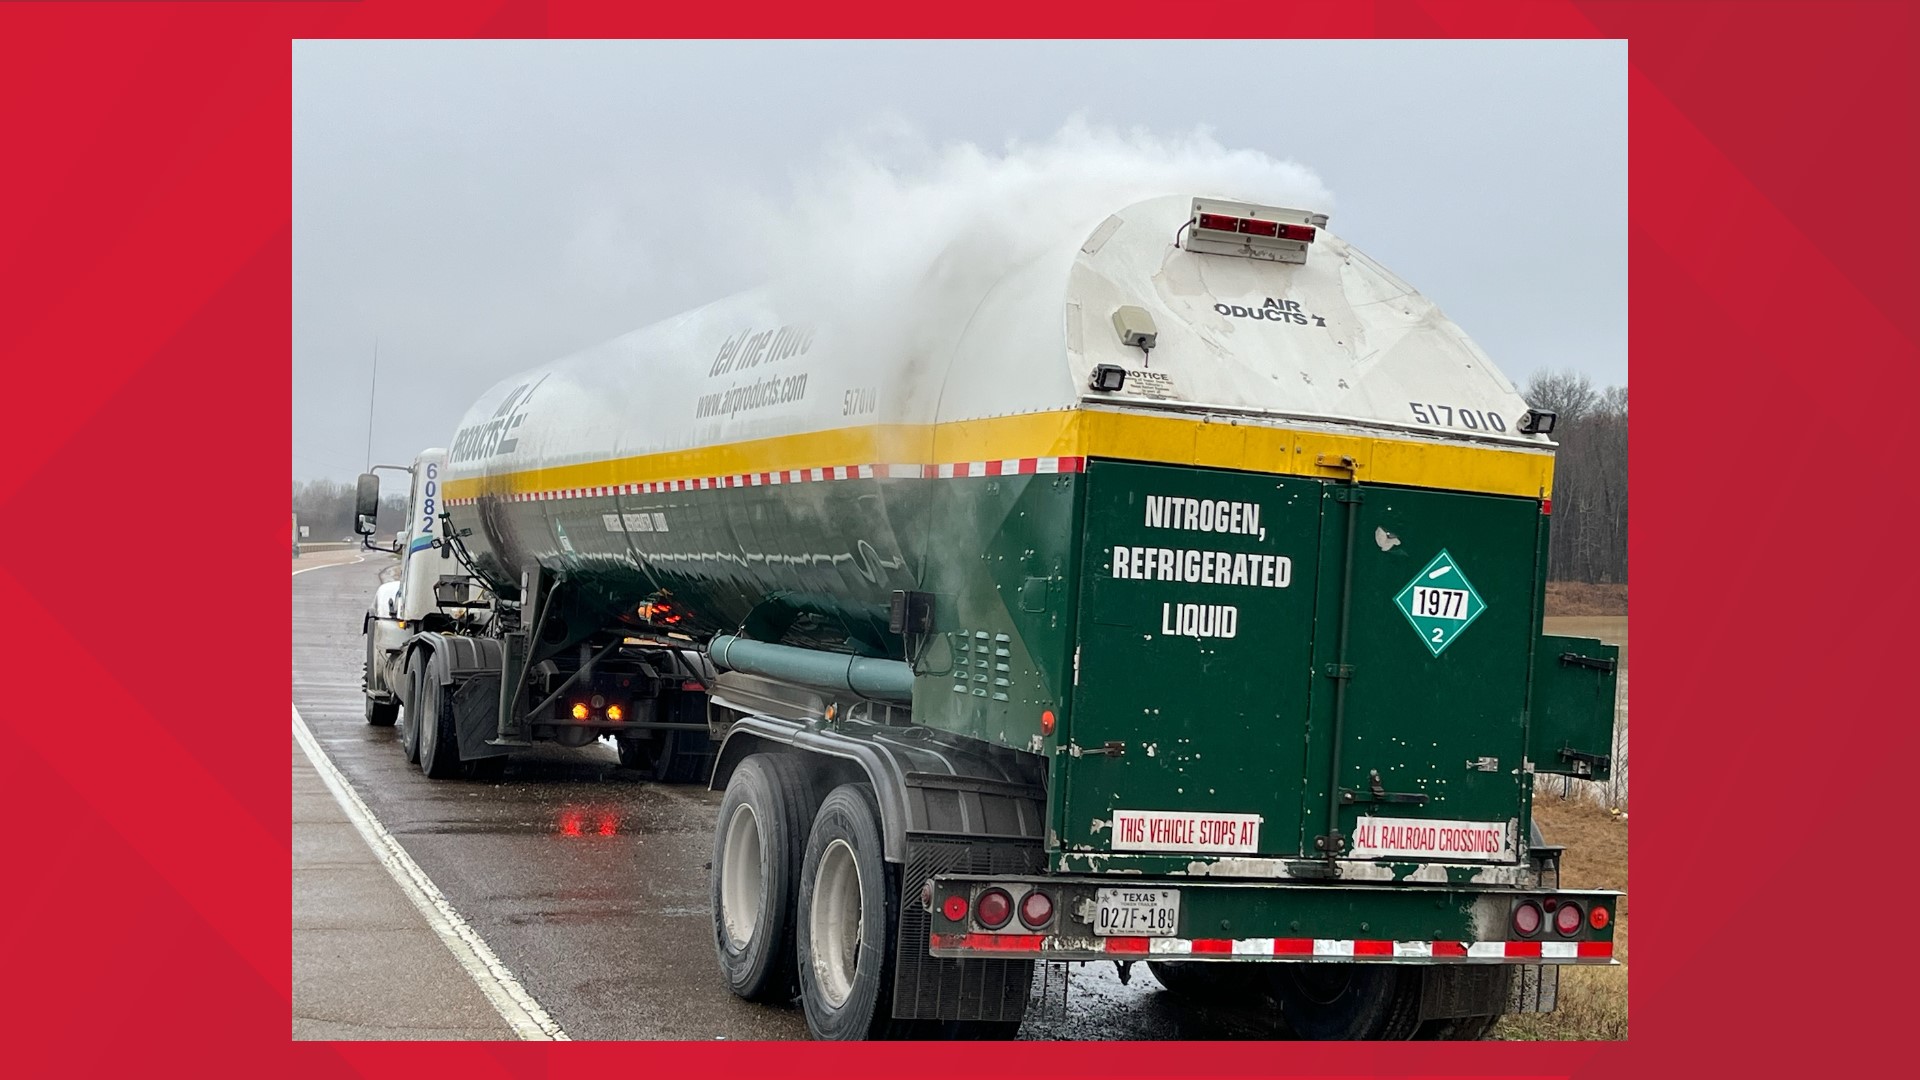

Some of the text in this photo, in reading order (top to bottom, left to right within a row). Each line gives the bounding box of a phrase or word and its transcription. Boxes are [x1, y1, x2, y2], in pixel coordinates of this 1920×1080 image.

[1263, 297, 1302, 312] AIR
[709, 324, 818, 378] tell me more
[1125, 370, 1169, 381] NOTICE
[696, 372, 808, 419] www.airproducts.com
[843, 386, 877, 416] 517010
[1409, 402, 1506, 432] 517010
[450, 418, 505, 463] PRODUCTS
[422, 463, 438, 533] 6082
[1145, 495, 1266, 541] NITROGEN,
[1112, 546, 1292, 588] REFRIGERATED
[1419, 589, 1463, 617] 1977
[1161, 602, 1238, 639] LIQUID
[1431, 627, 1444, 643] 2
[1120, 818, 1256, 846] THIS VEHICLE STOPS AT
[1357, 825, 1500, 853] ALL RAILROAD CROSSINGS
[1122, 893, 1156, 902] TEXAS
